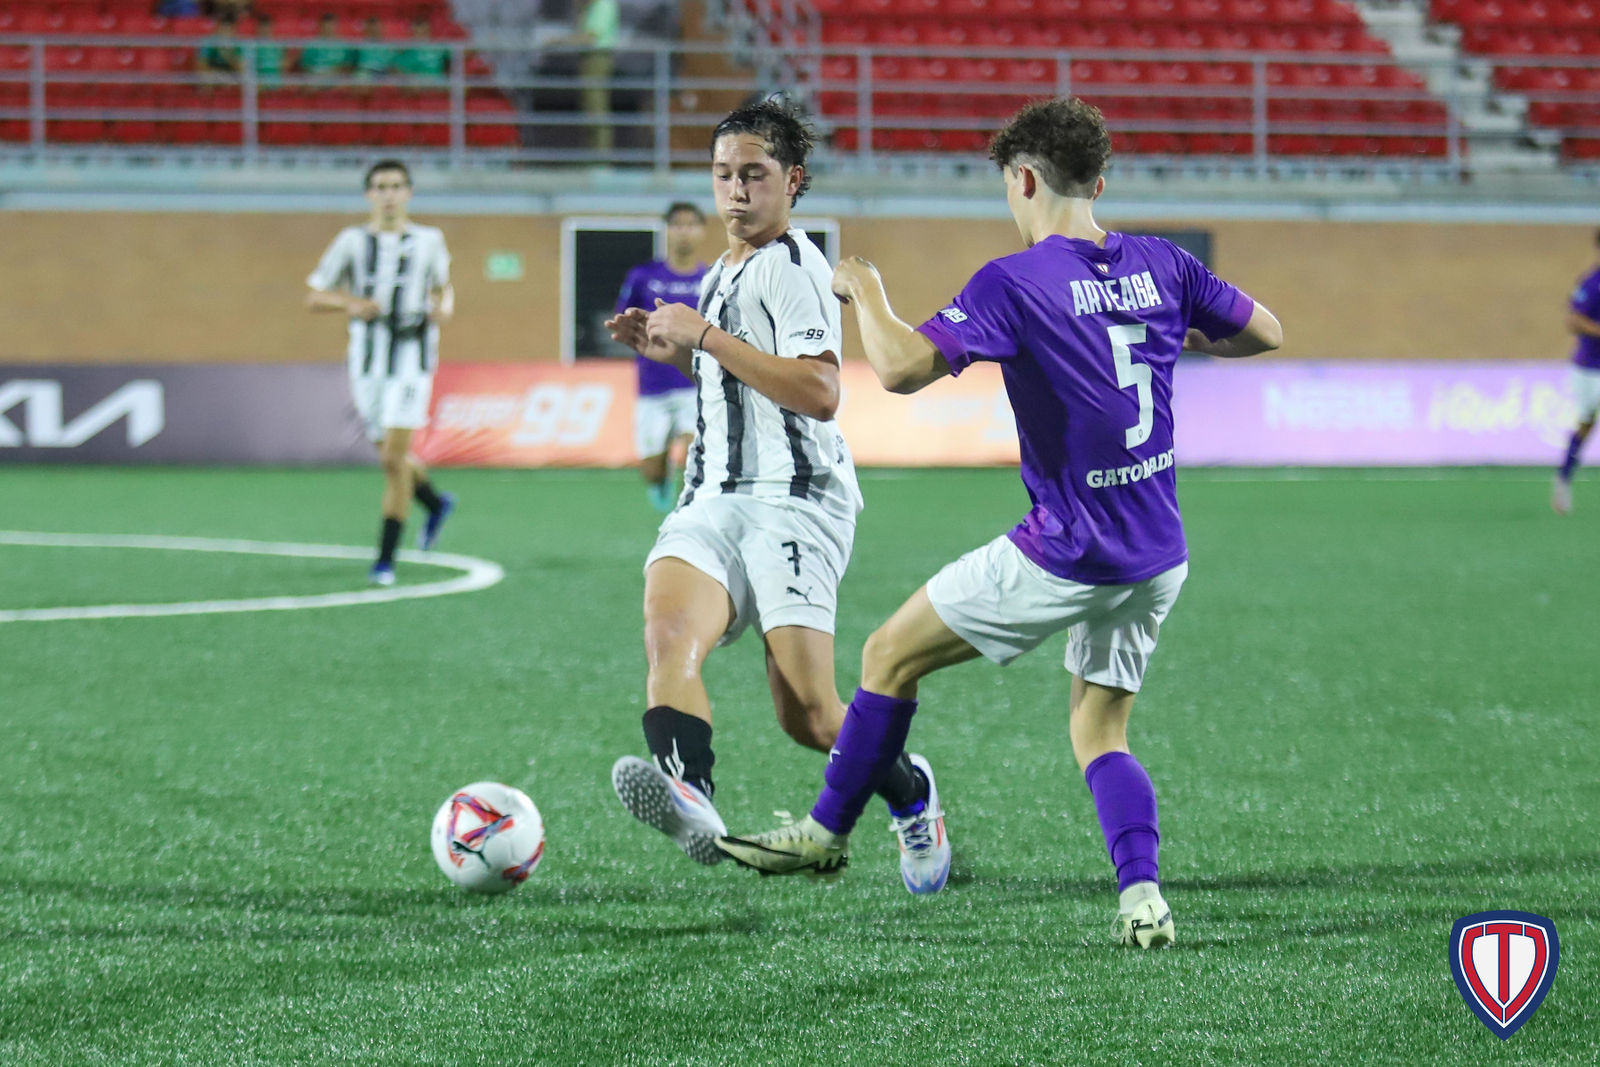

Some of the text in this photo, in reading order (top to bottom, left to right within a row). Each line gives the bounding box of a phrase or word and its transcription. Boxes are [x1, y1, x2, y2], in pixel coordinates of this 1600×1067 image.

[1069, 270, 1163, 317] ARTEAGA
[804, 328, 825, 340] 99
[1106, 324, 1154, 450] 5
[511, 383, 613, 447] 99
[1086, 449, 1174, 489] GATORADE
[781, 541, 802, 577] 7
